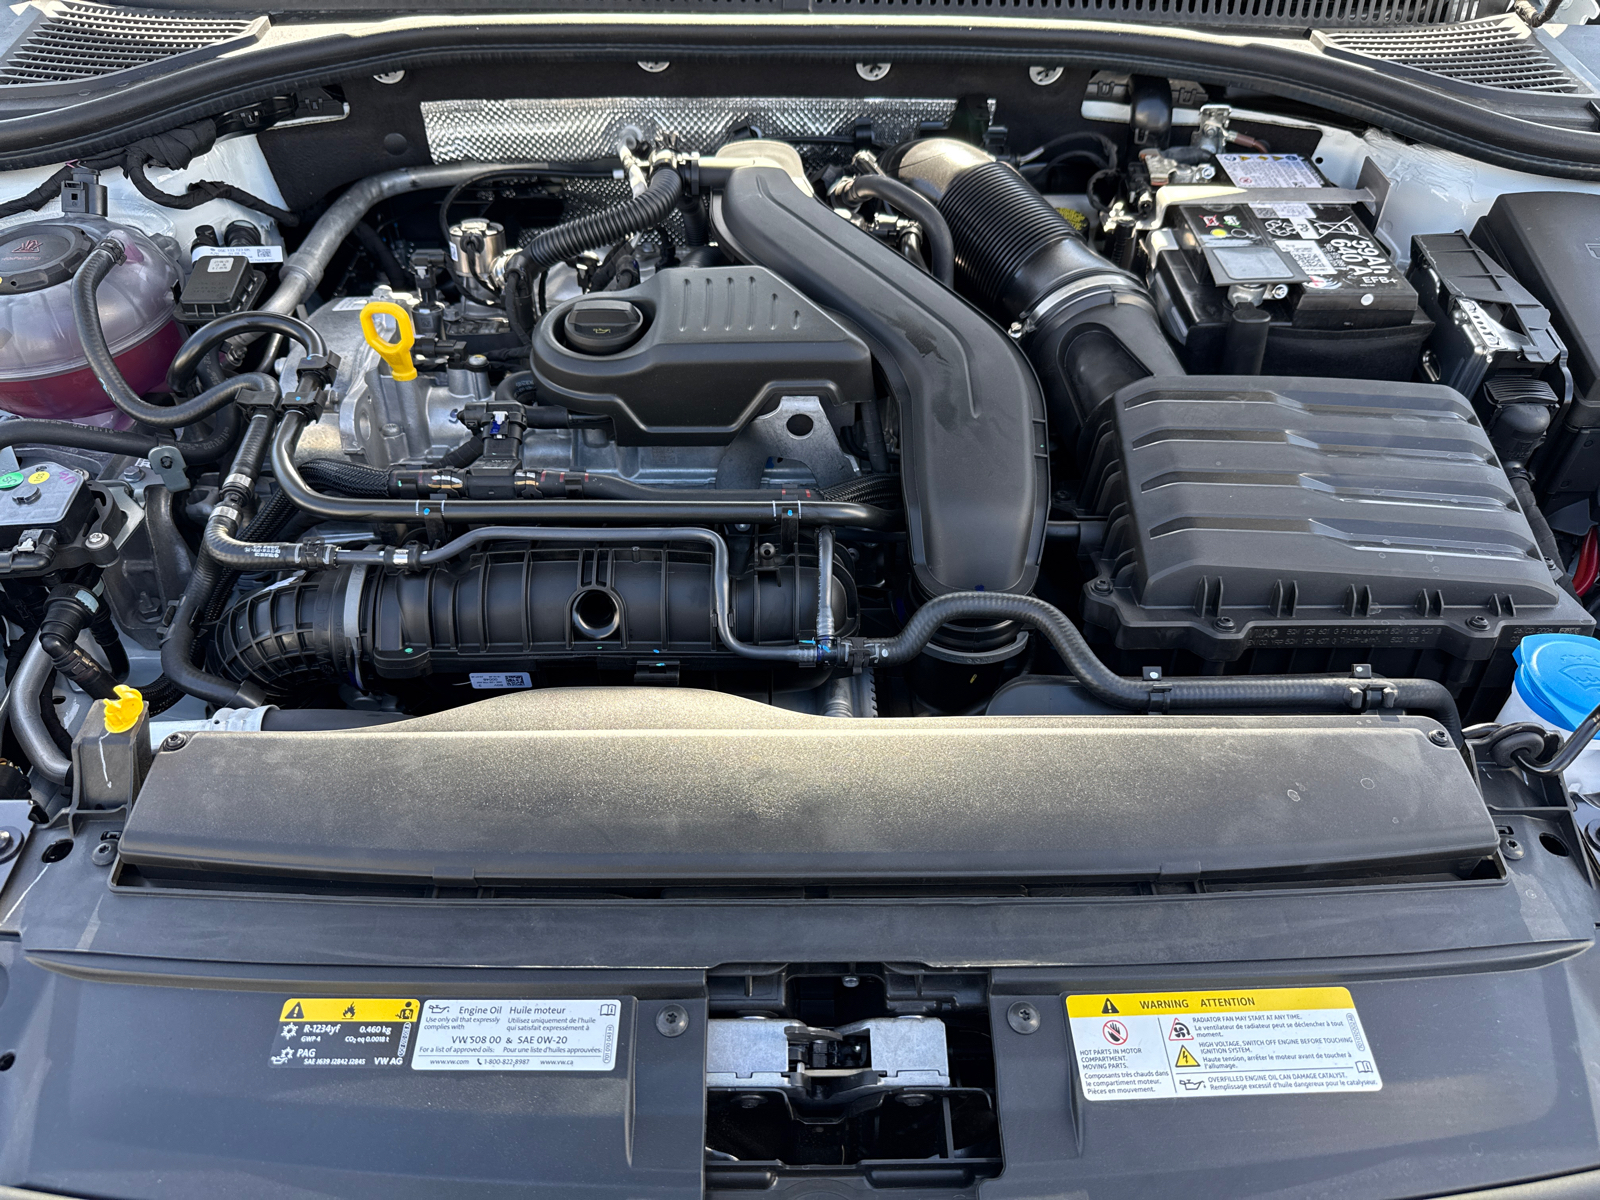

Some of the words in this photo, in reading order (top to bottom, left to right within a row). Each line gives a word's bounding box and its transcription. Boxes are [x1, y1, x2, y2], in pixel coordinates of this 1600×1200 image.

[1330, 239, 1364, 262] 640
[1348, 265, 1372, 276] A
[1352, 240, 1391, 274] 59Ah
[1362, 276, 1398, 284] EFB+
[1139, 999, 1189, 1009] WARNING
[1200, 997, 1255, 1007] ATTENTION
[459, 1006, 488, 1016] Engine
[489, 1006, 502, 1014] Oil
[472, 1016, 500, 1025] expressly
[303, 1024, 341, 1035] R-1234yf
[382, 1026, 392, 1035] kg
[296, 1049, 316, 1057] PAG
